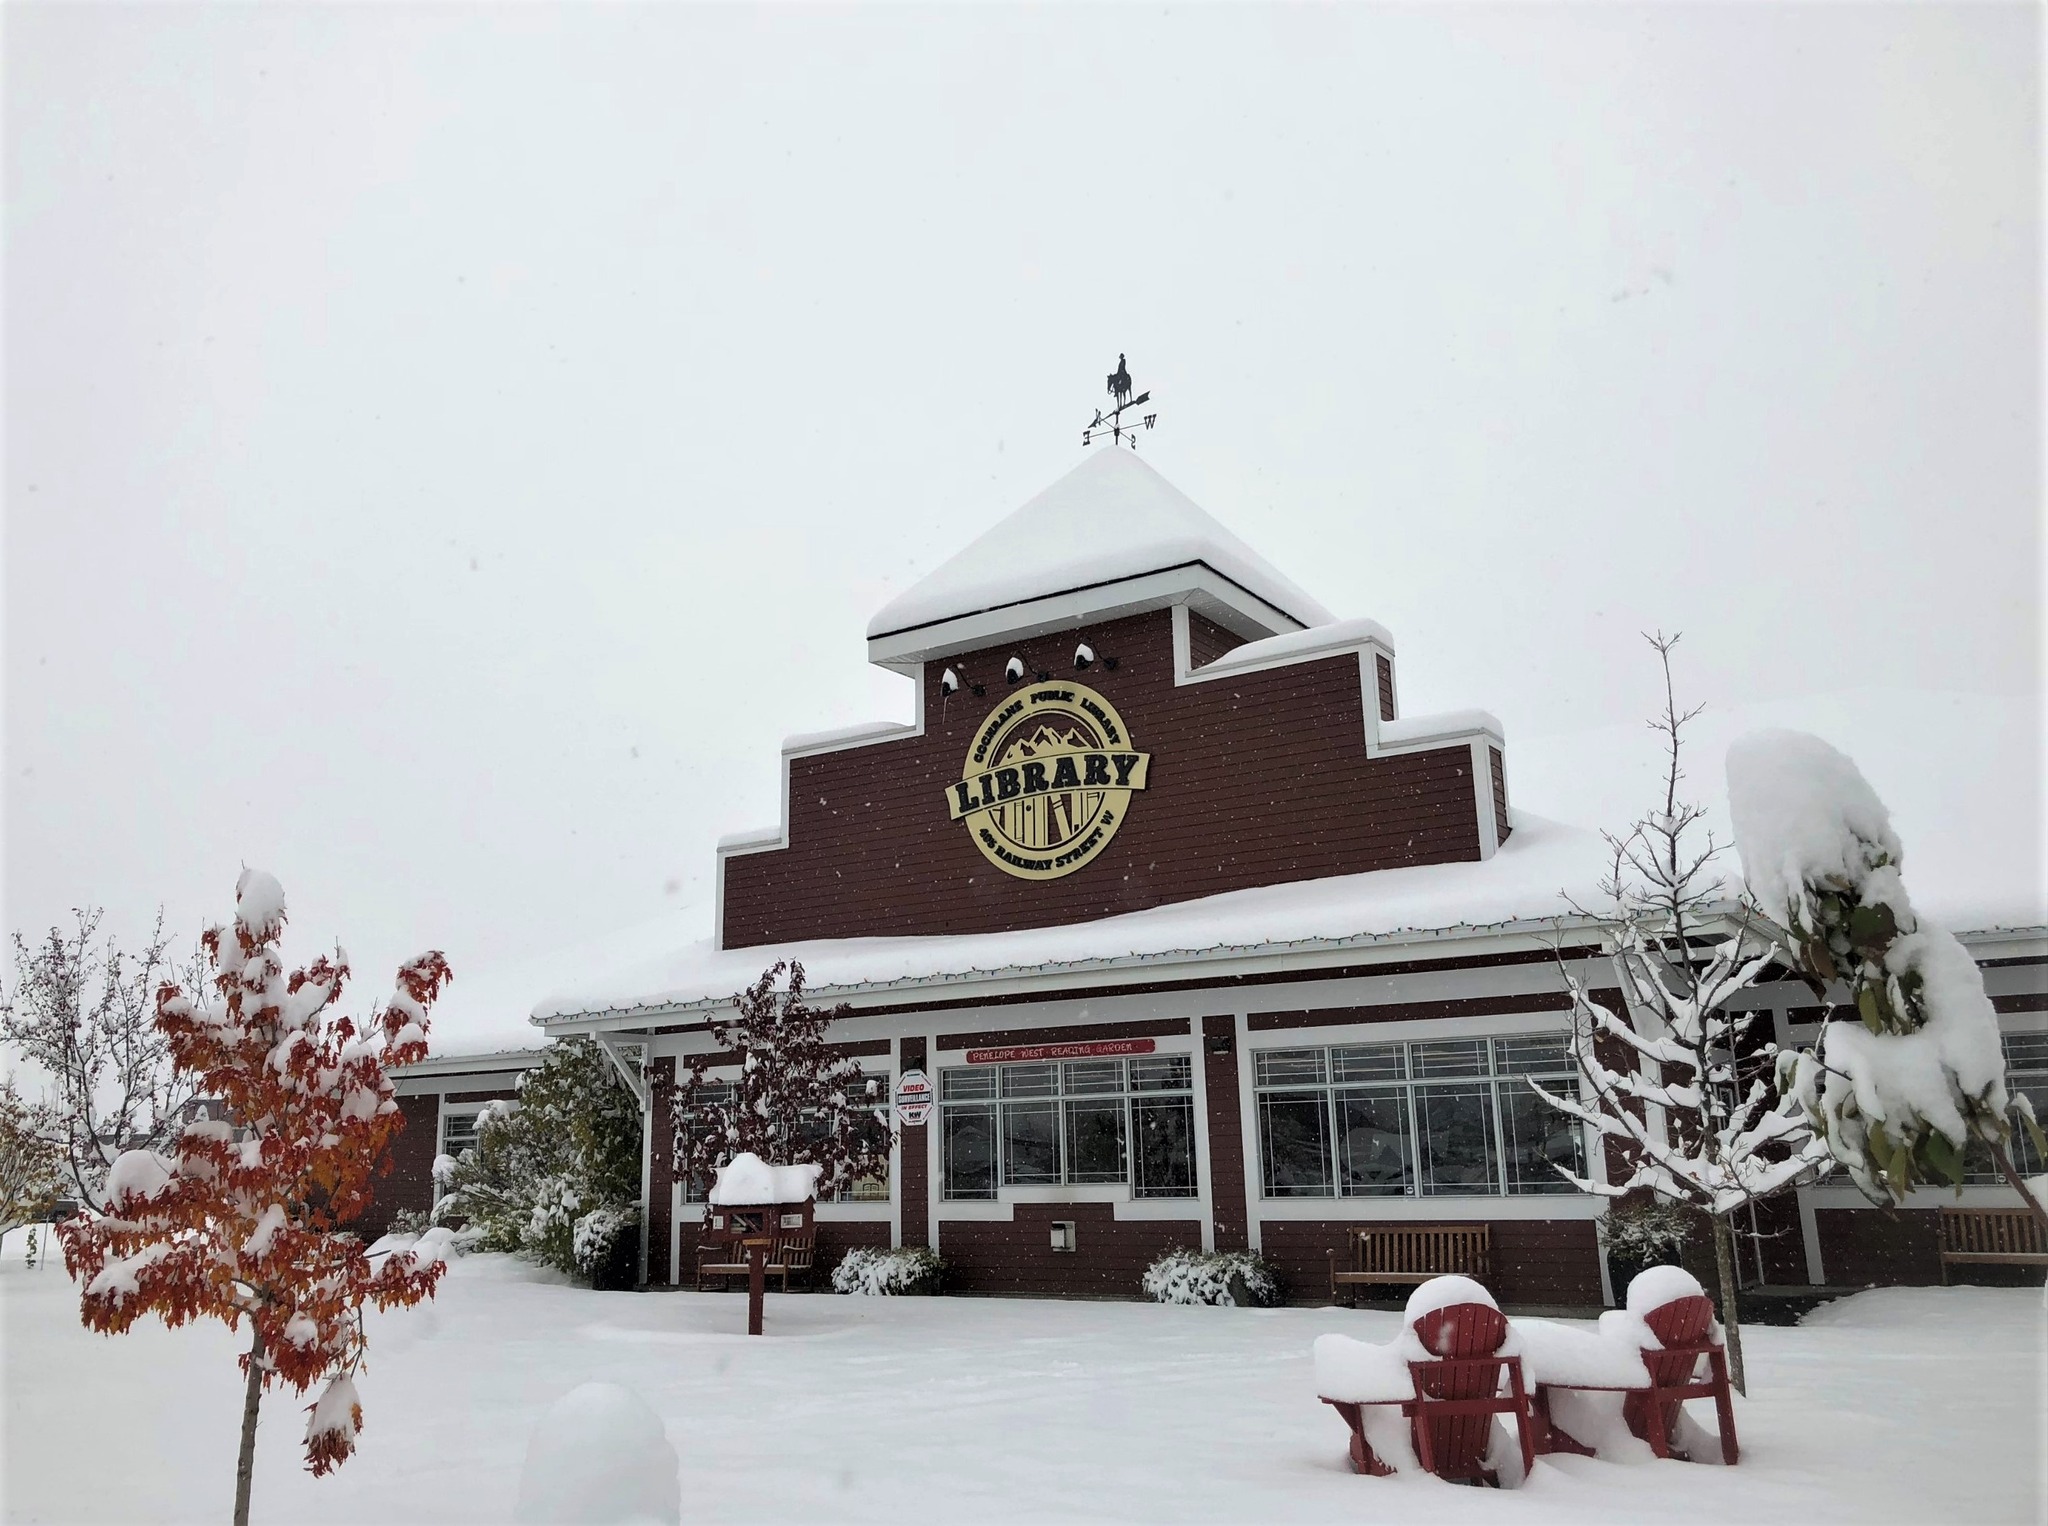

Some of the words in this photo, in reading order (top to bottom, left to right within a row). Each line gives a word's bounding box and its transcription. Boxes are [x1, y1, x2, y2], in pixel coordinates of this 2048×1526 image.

[1143, 413, 1157, 430] W
[973, 700, 1024, 763] COCHRANE
[1029, 690, 1075, 704] PUBLIC
[1080, 697, 1121, 745] LIBRARY
[955, 754, 1139, 813] LIBRARY
[994, 845, 1053, 871] RAILWAY
[1055, 826, 1105, 868] STREET
[1100, 809, 1115, 826] W
[972, 1050, 1016, 1061] PENELOPE
[1021, 1048, 1044, 1058] WEST
[1051, 1045, 1091, 1056] READING
[1096, 1043, 1132, 1053] GARDEN
[903, 1084, 924, 1092] VIDEO
